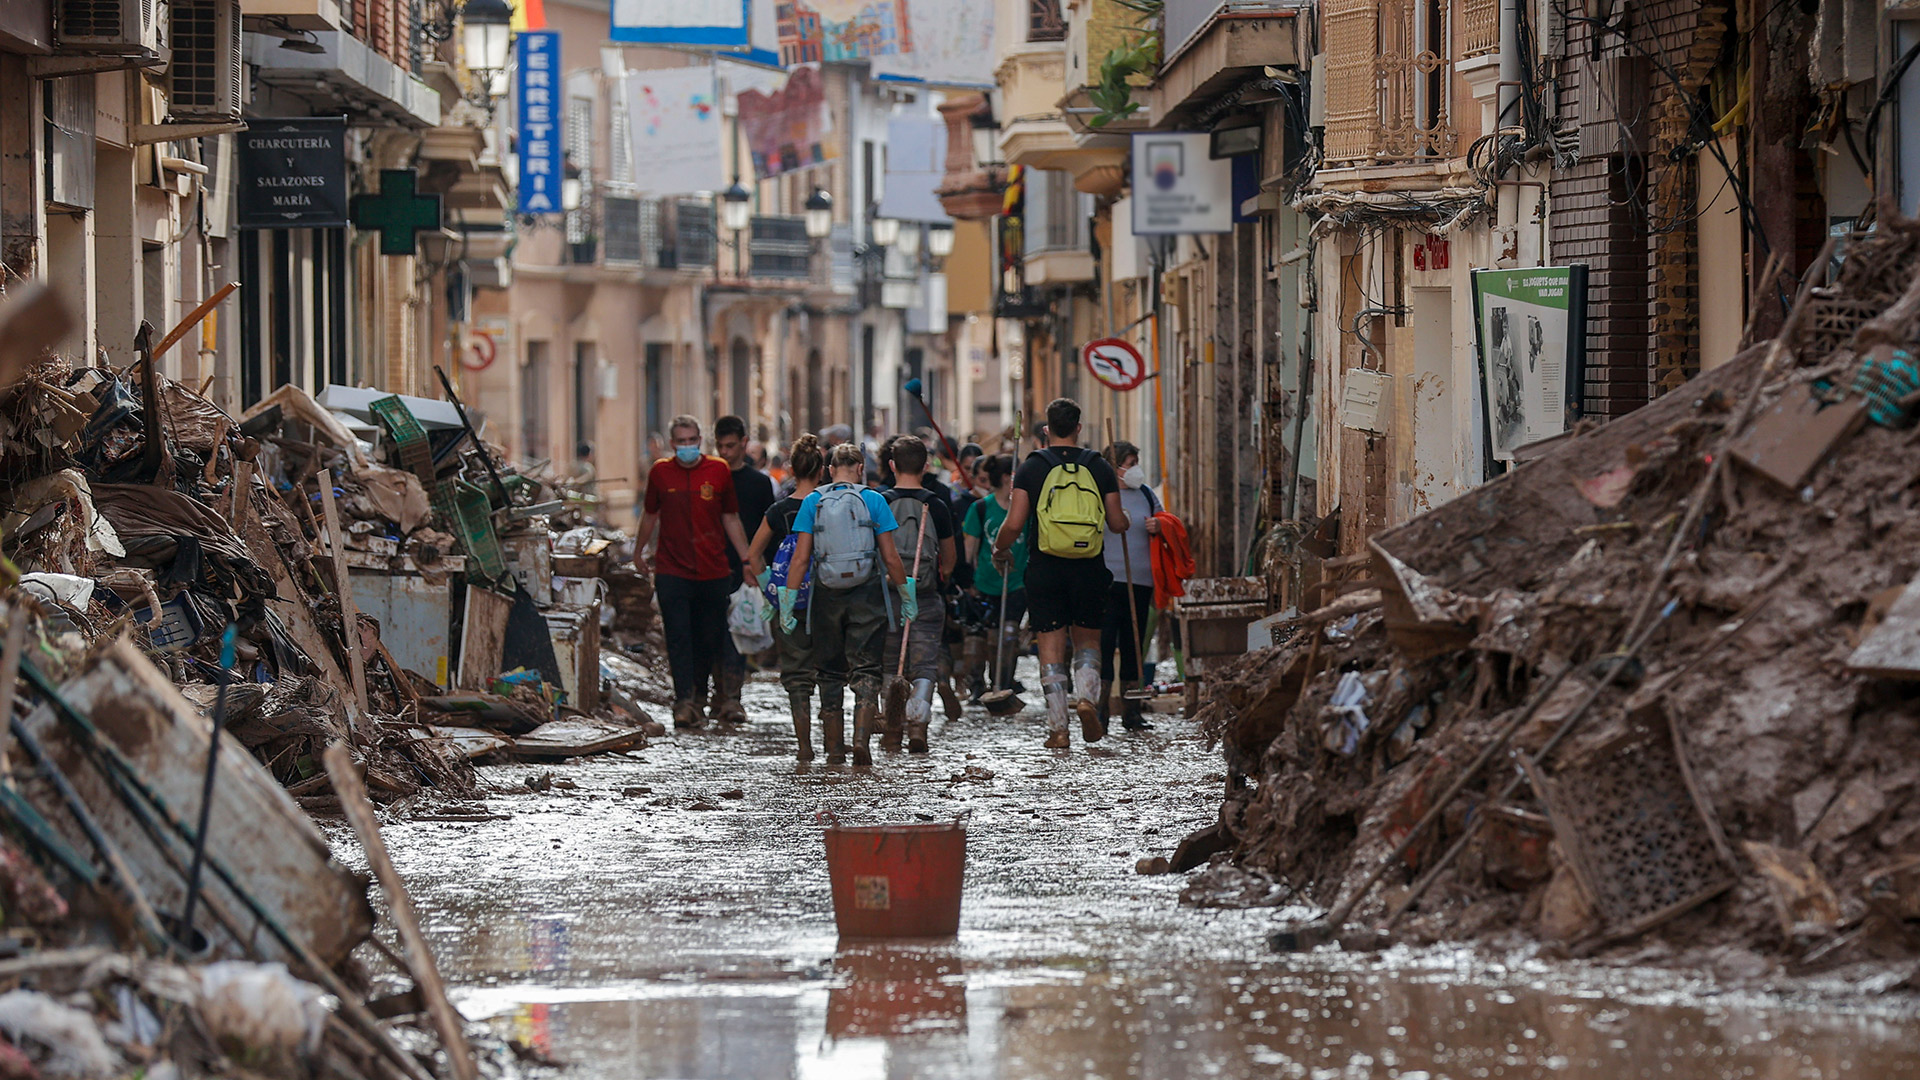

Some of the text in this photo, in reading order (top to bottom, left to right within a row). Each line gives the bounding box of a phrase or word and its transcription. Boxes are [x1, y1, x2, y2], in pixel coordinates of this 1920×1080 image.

[525, 35, 553, 209] FERRETERIA
[248, 136, 331, 149] CHARCUTERÍA
[286, 157, 294, 167] Y
[257, 176, 325, 187] SALAZONES
[273, 193, 311, 206] MARÍA
